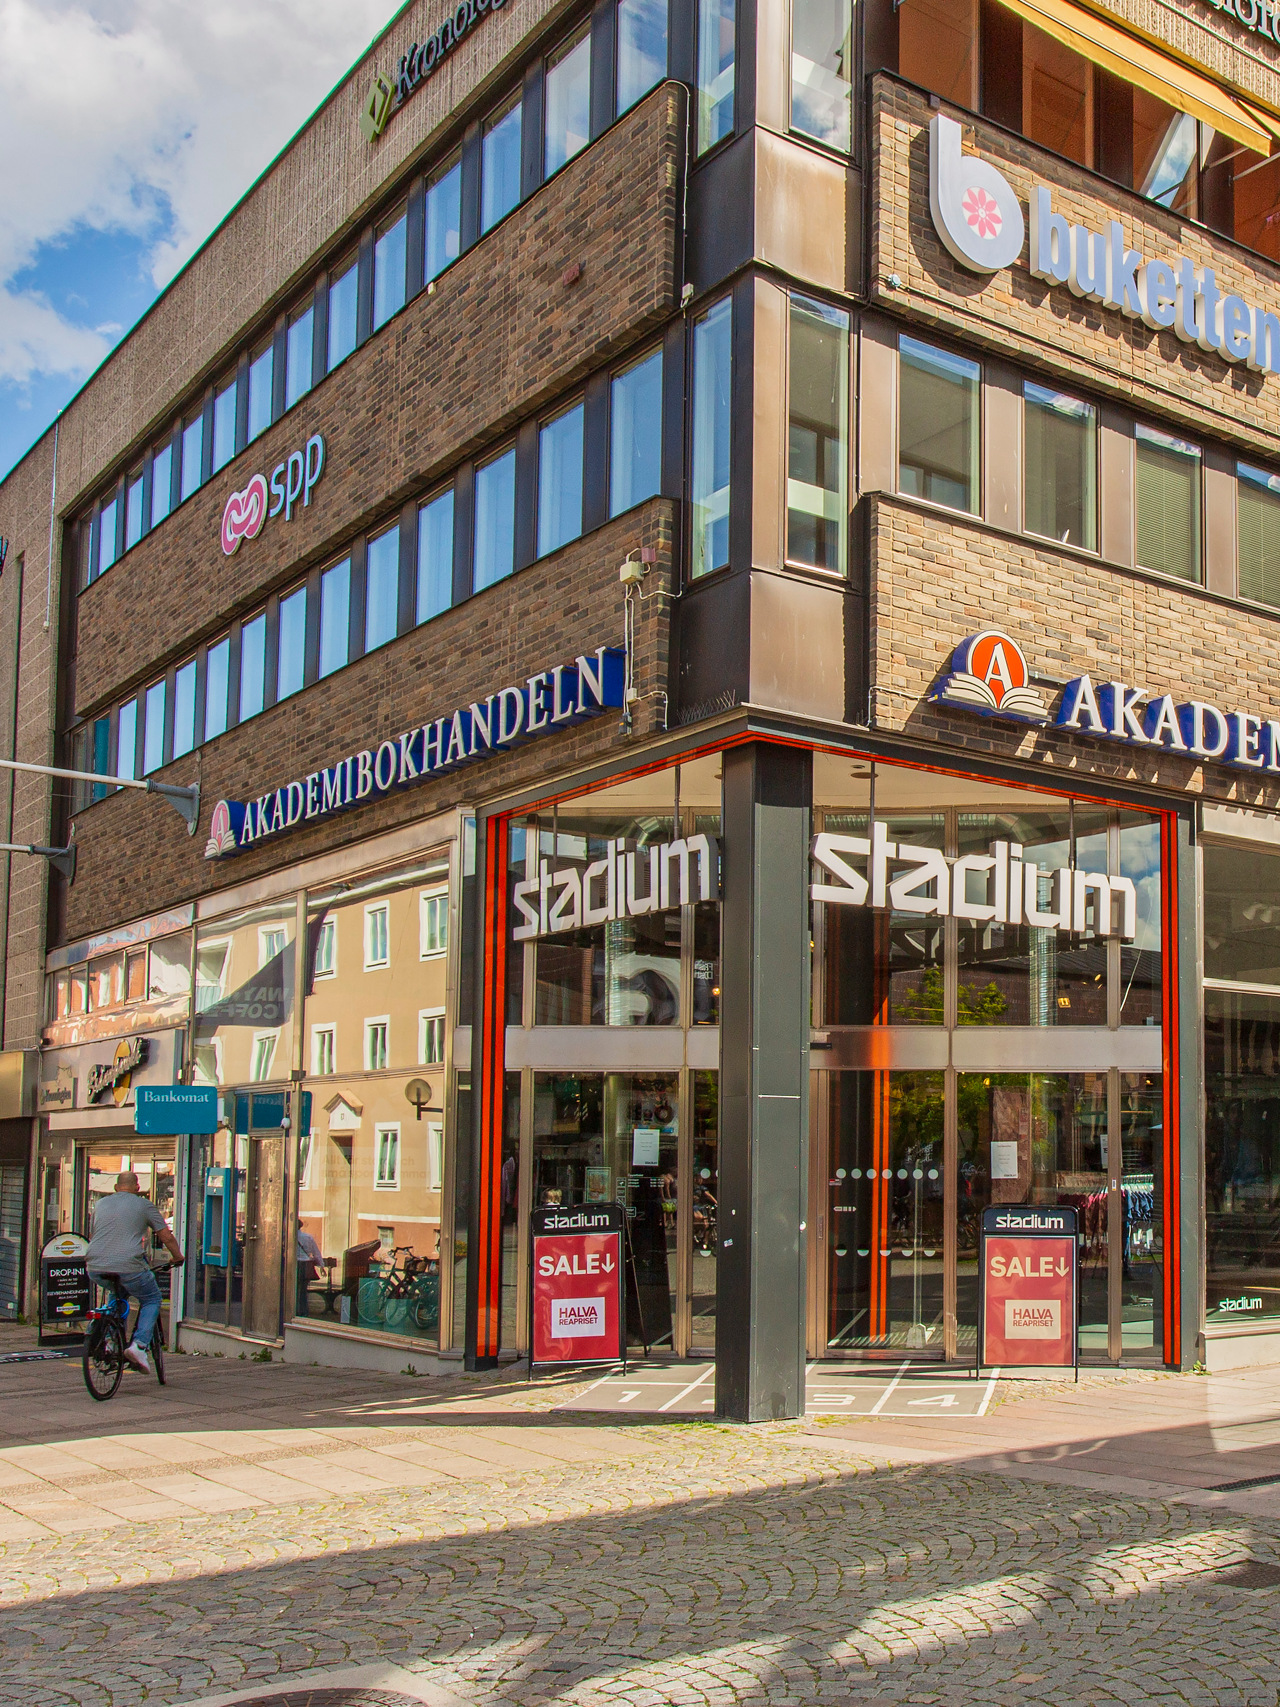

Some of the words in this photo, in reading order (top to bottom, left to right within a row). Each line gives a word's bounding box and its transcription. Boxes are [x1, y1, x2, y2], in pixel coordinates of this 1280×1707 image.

[269, 434, 327, 521] spp
[240, 645, 607, 845] AKADEMIBOKHANDELN
[512, 833, 722, 942] stadium
[809, 820, 1137, 940] stadium
[144, 1090, 209, 1103] Bankomat
[544, 1213, 610, 1229] stadium
[995, 1213, 1064, 1229] stadium
[538, 1253, 600, 1277] SALE
[990, 1256, 1054, 1278] SALE
[559, 1306, 598, 1318] HALVA
[1219, 1296, 1263, 1312] stadium
[559, 1317, 598, 1326] REAPRISET
[1012, 1308, 1053, 1320] HALVA
[1012, 1319, 1053, 1327] REAPRISET
[907, 1394, 959, 1407] 4
